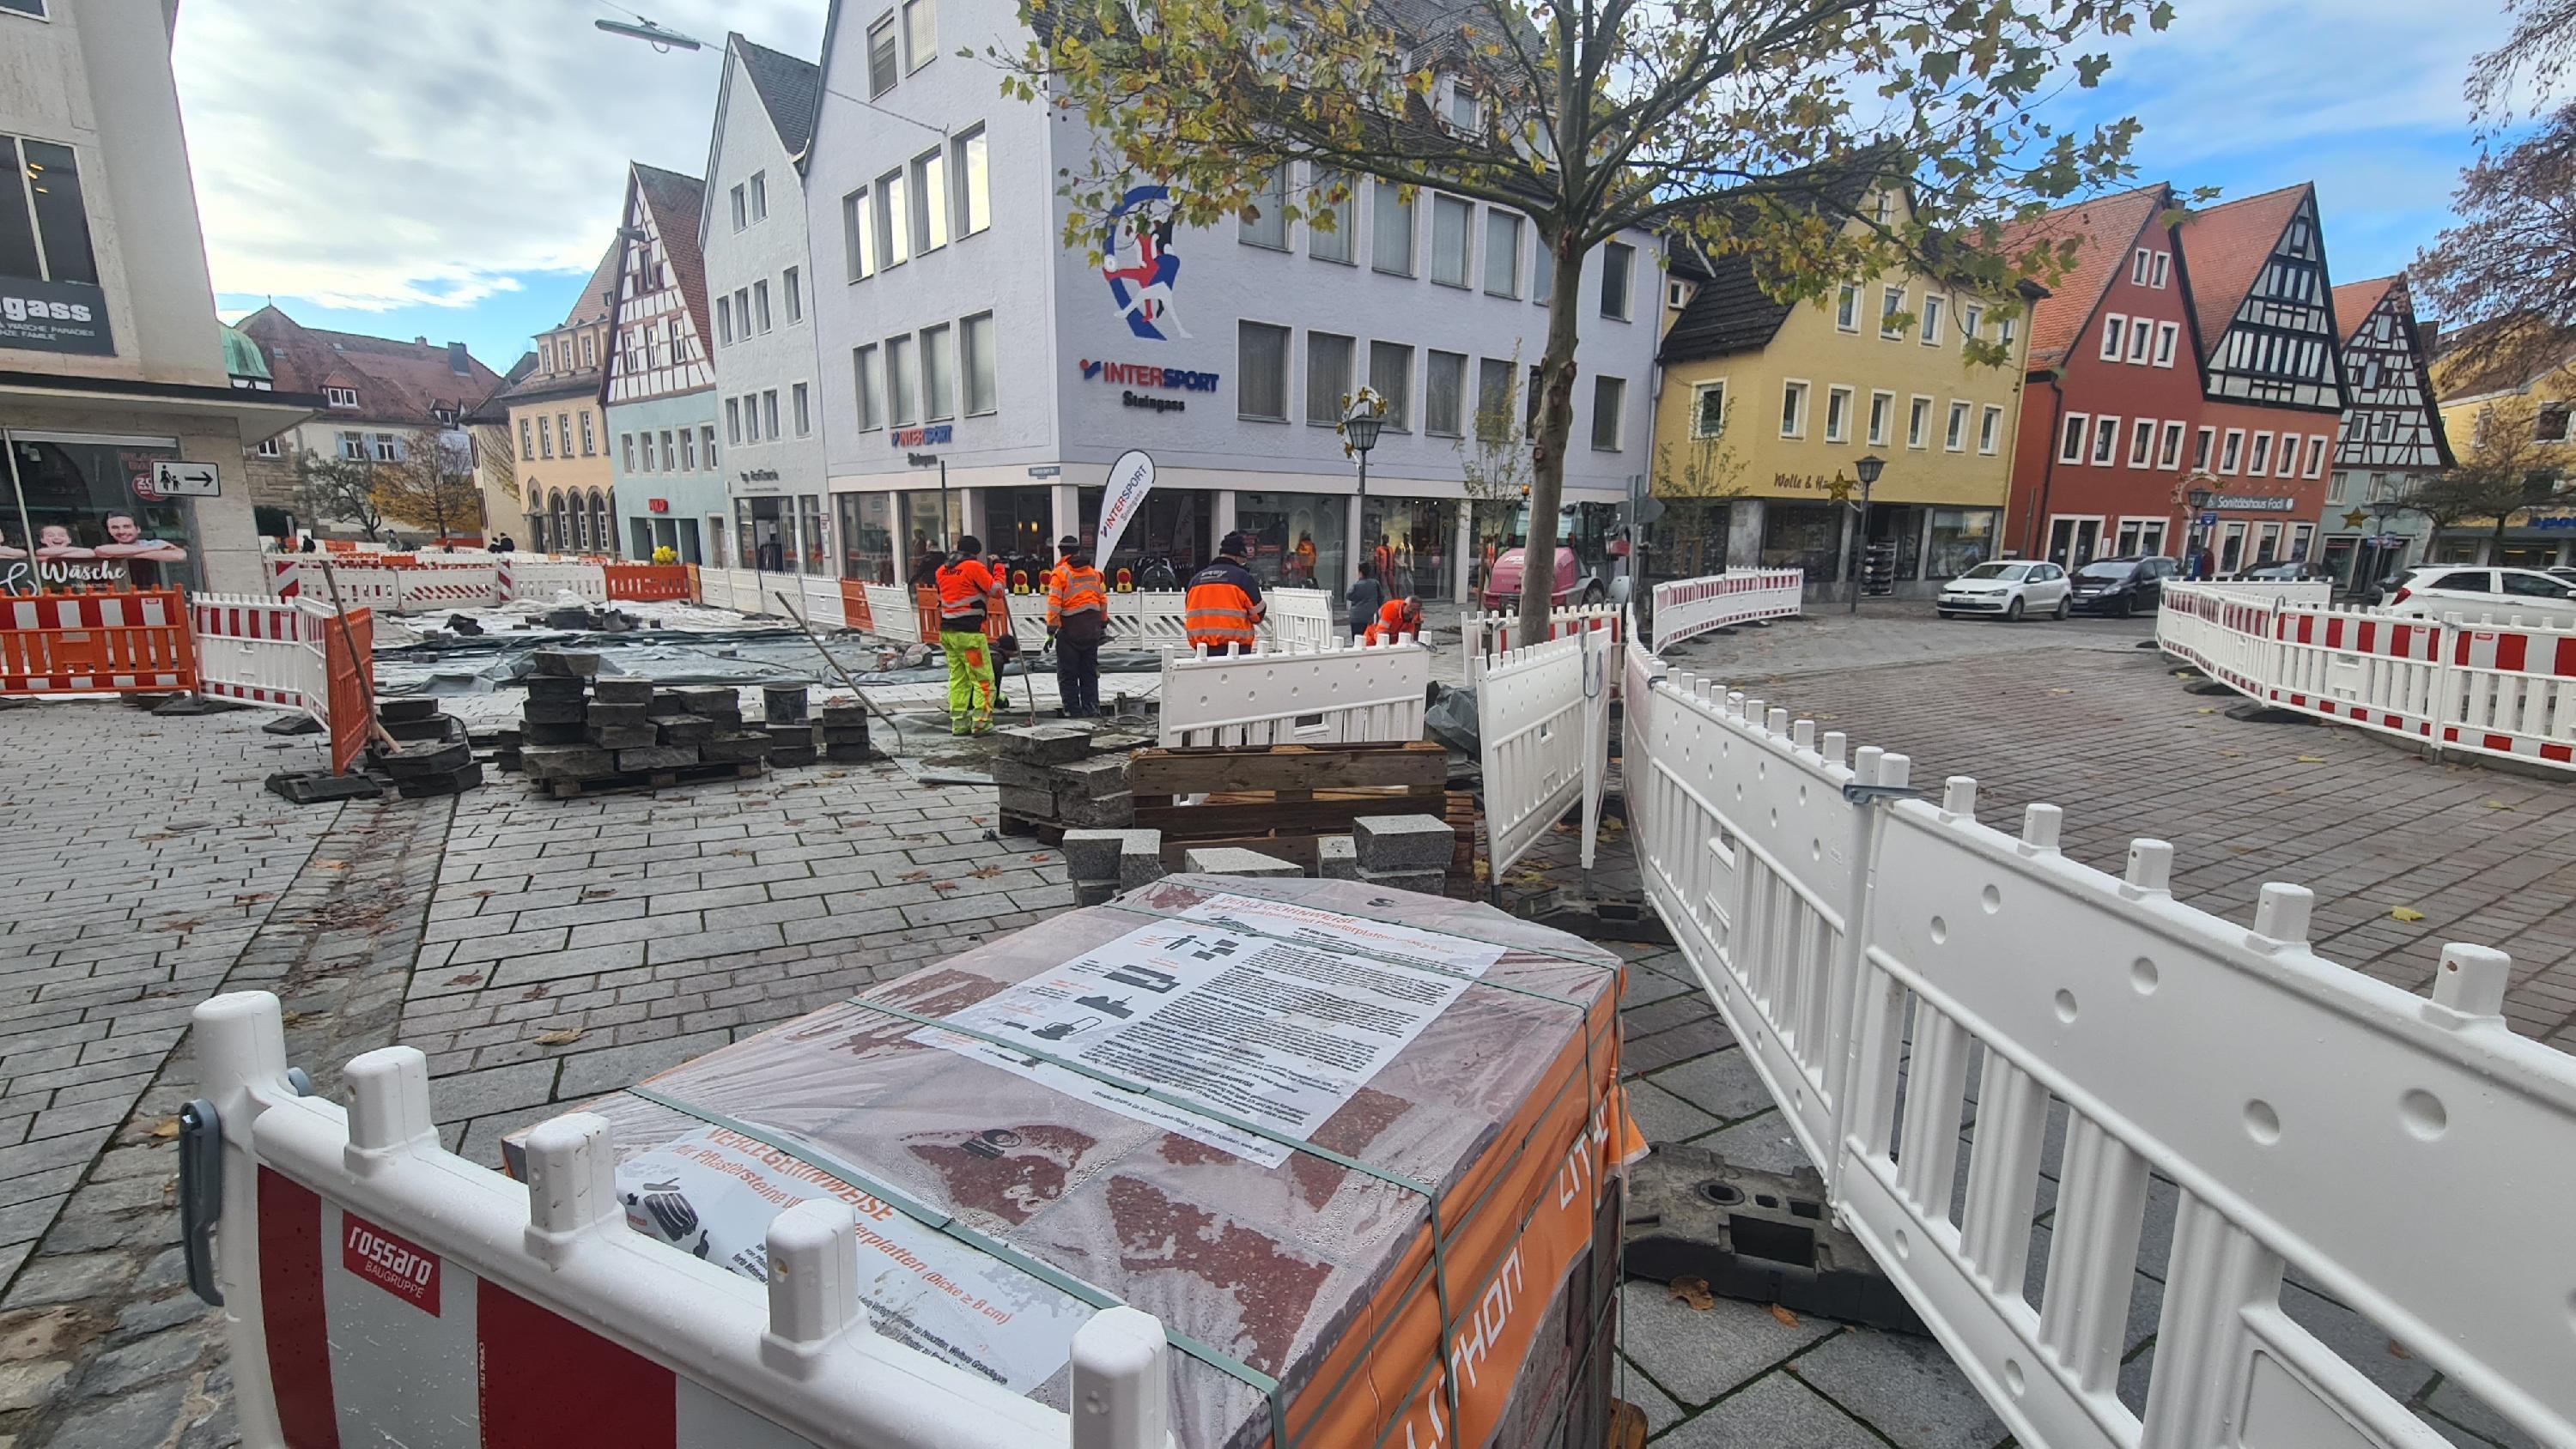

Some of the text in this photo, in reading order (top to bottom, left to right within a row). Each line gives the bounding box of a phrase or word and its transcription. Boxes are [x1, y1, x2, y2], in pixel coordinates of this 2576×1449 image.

[0, 297, 92, 322] gass
[1103, 361, 1219, 393] INTERSPORT
[1122, 390, 1185, 413] Steingass
[1105, 464, 1147, 530] INTERSPORT
[1774, 473, 1801, 488] Wolle
[1805, 475, 1812, 489] &
[2217, 495, 2267, 509] Sanitätshaus
[41, 560, 126, 583] Wäsche
[692, 1149, 787, 1204] Pflastersteine
[705, 1126, 893, 1222] VERLEGEHINWEISE
[348, 1226, 433, 1286] rossaro
[855, 1222, 927, 1272] terplatten
[921, 1271, 963, 1297] (Dicke
[972, 1298, 986, 1310] 8
[982, 1305, 1014, 1325] cm)
[365, 1261, 425, 1299] BAUGRUPPE
